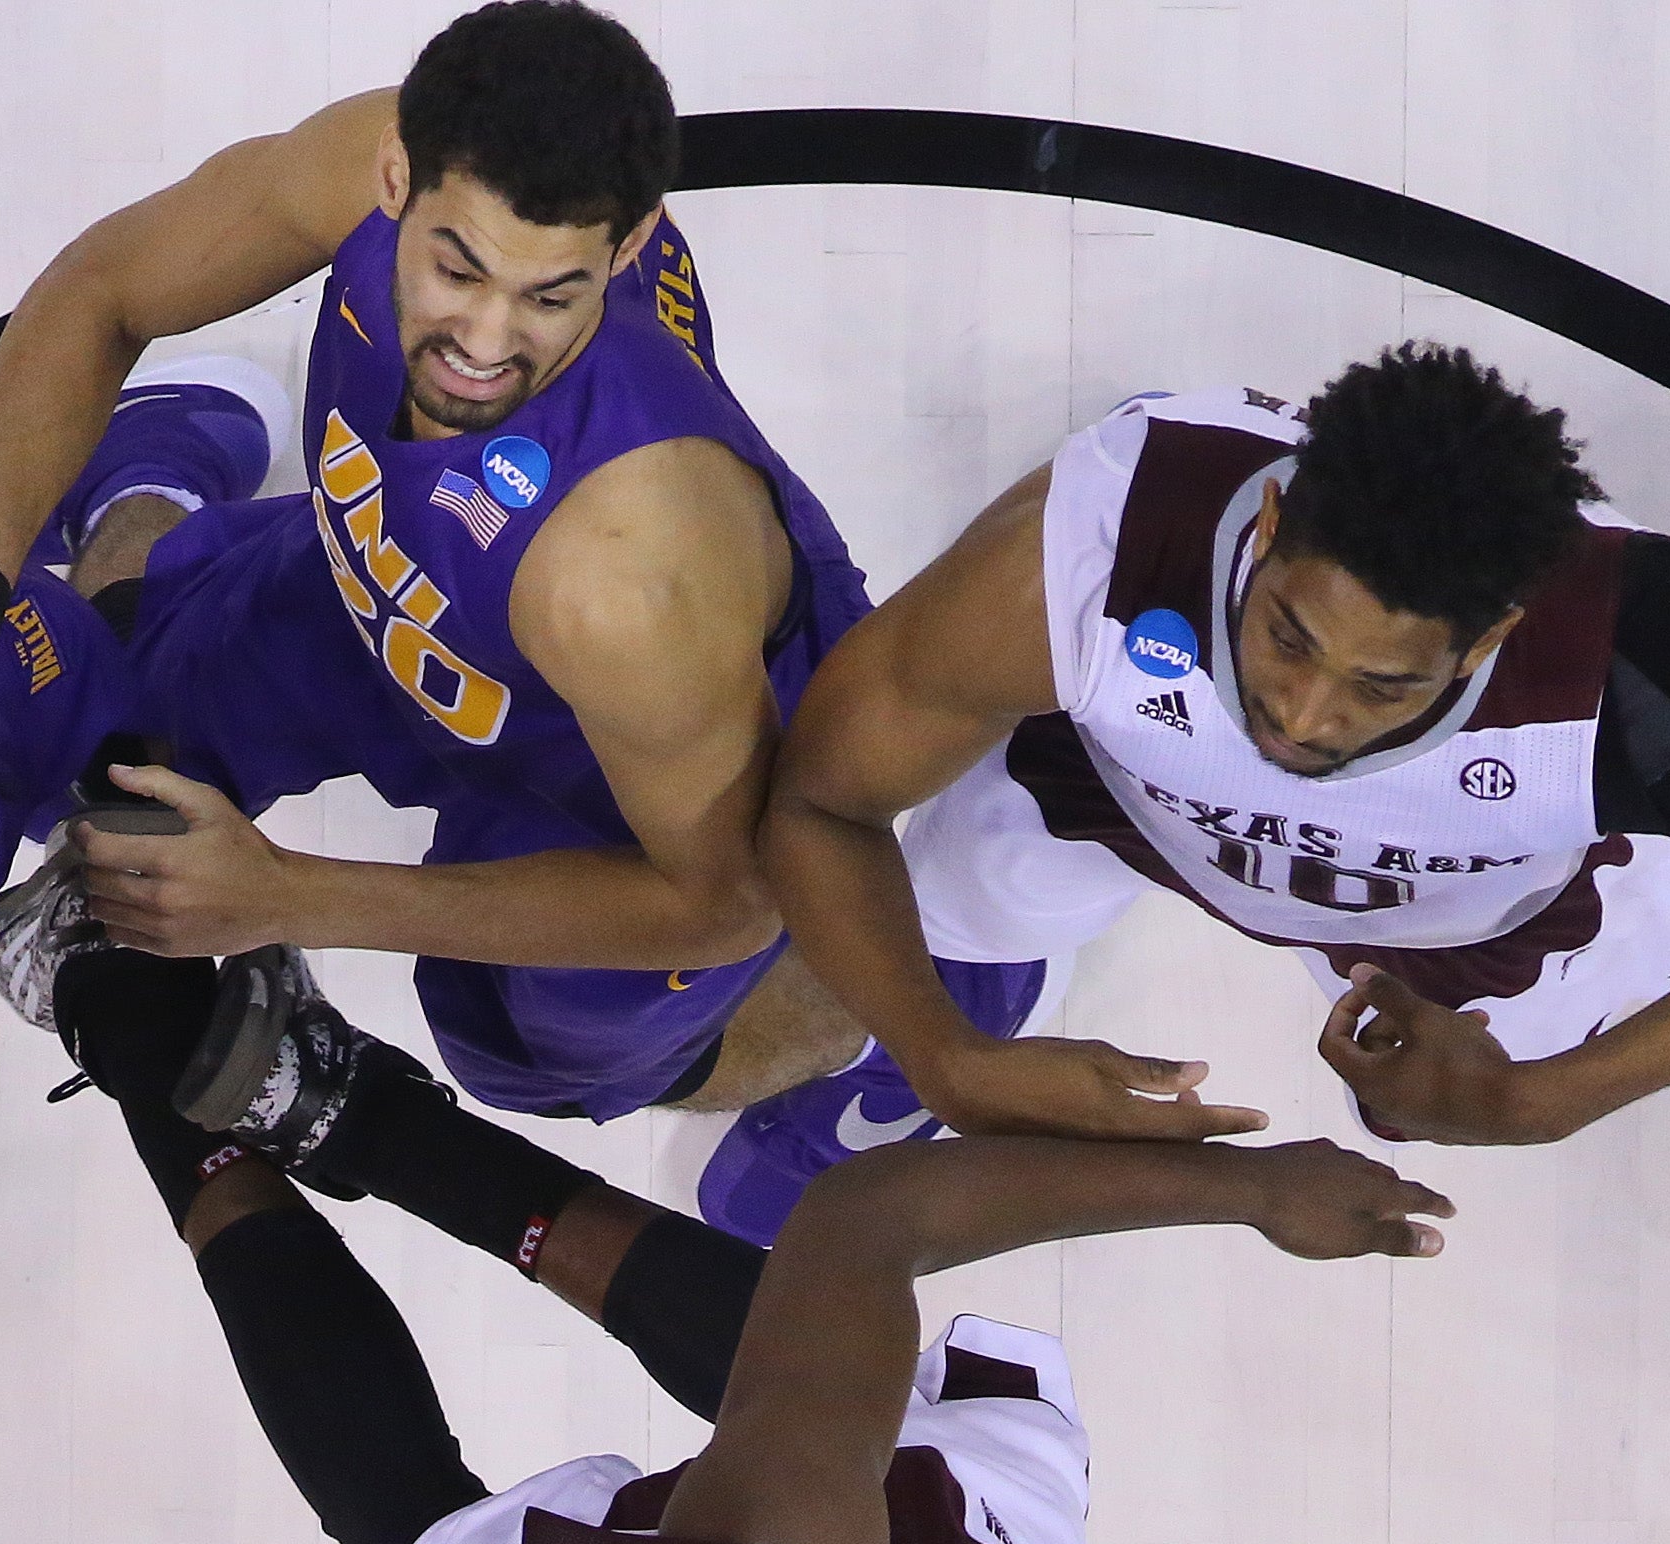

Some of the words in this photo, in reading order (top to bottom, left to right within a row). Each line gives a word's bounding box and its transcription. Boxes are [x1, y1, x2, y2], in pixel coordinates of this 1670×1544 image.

[486, 452, 539, 505] NCAA
[319, 407, 451, 630] UNI
[4, 599, 62, 694] VALLEY
[1131, 635, 1192, 672] NCAA
[1136, 703, 1194, 737] adidas
[1463, 760, 1513, 799] SEC
[1119, 765, 1343, 858] EXAS
[1370, 842, 1535, 874] A&M
[1195, 824, 1416, 914] 10
